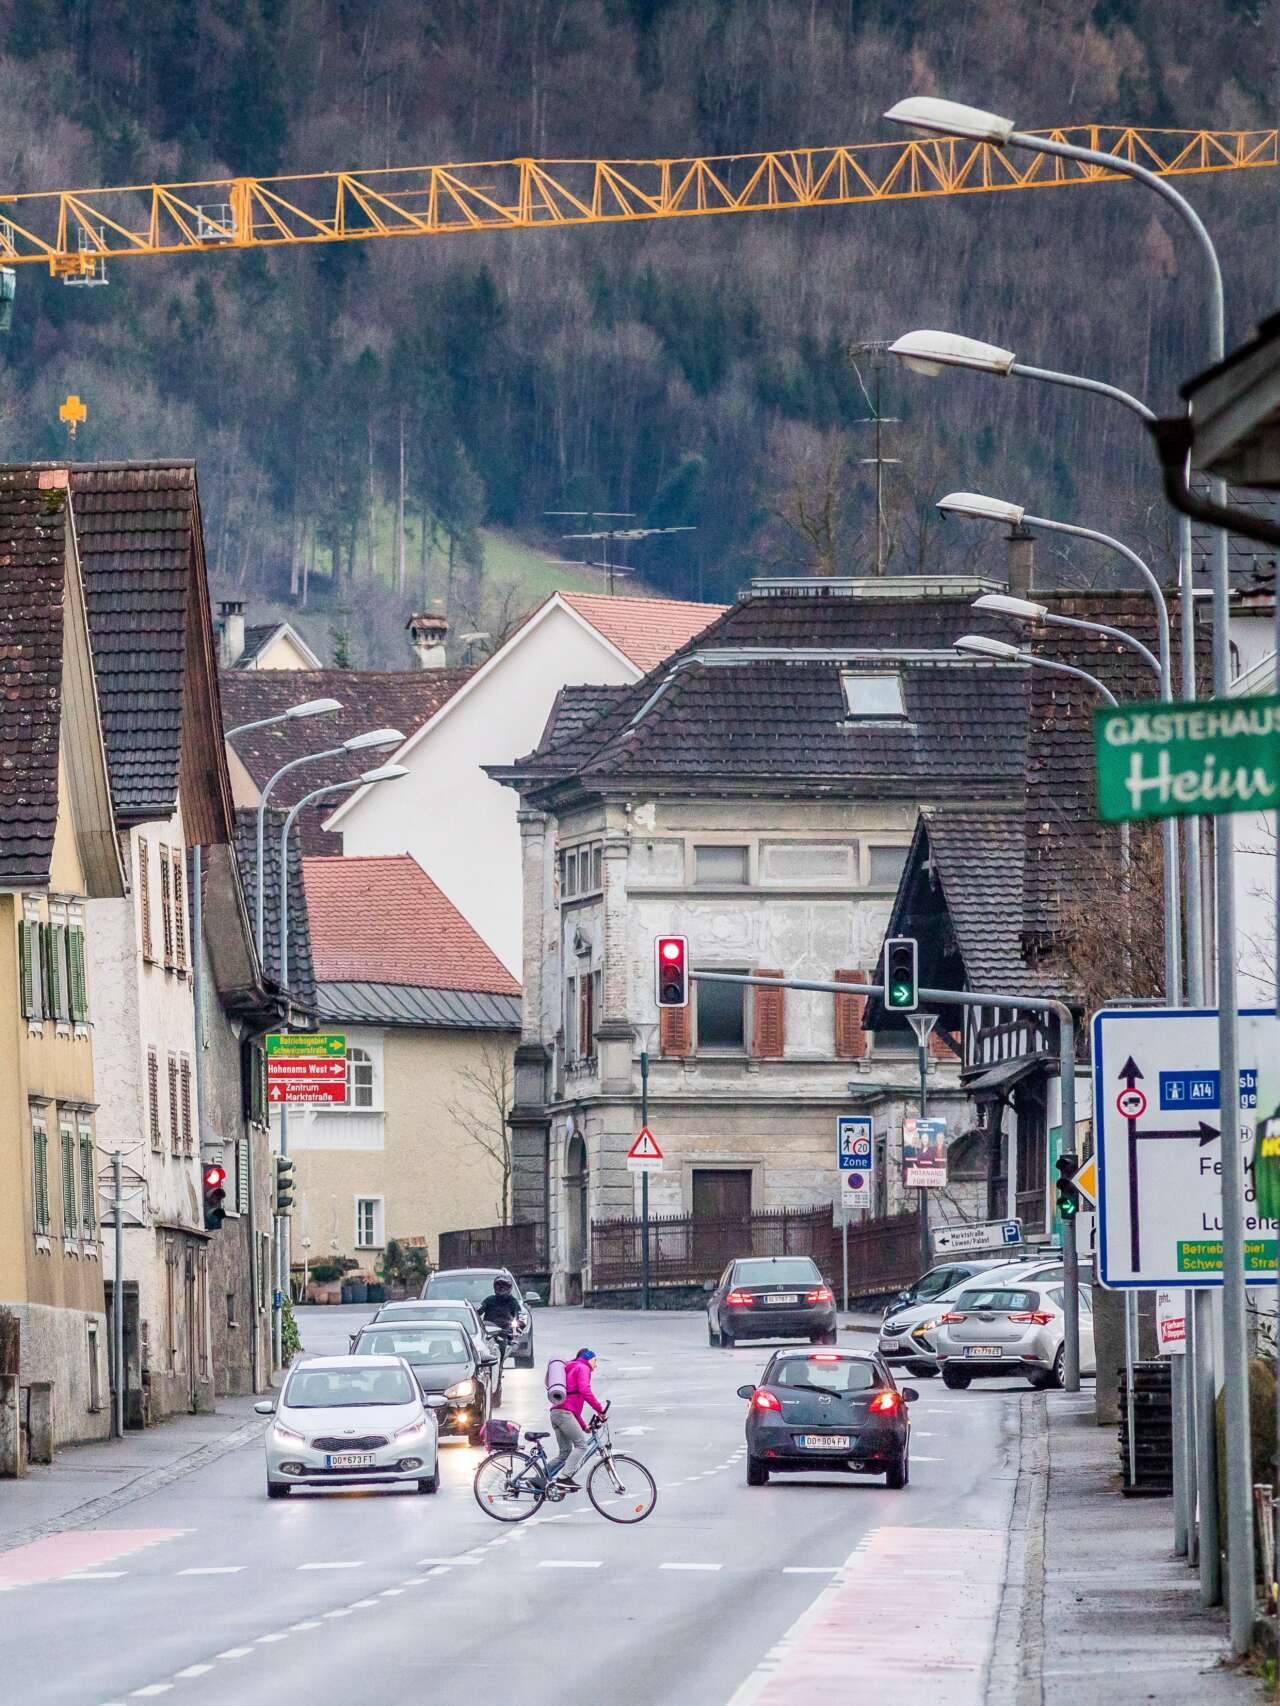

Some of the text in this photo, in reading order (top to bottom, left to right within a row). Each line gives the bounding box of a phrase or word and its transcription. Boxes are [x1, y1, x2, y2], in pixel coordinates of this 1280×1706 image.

[268, 1064, 327, 1074] Hohenems West
[286, 1083, 320, 1092] Zentrum
[1192, 1083, 1212, 1097] A14
[286, 1093, 333, 1101] Marktstraße
[857, 1143, 868, 1153] 20
[843, 1156, 869, 1168] Zone
[951, 1229, 984, 1239] Marktstraße
[348, 1456, 362, 1464] 673
